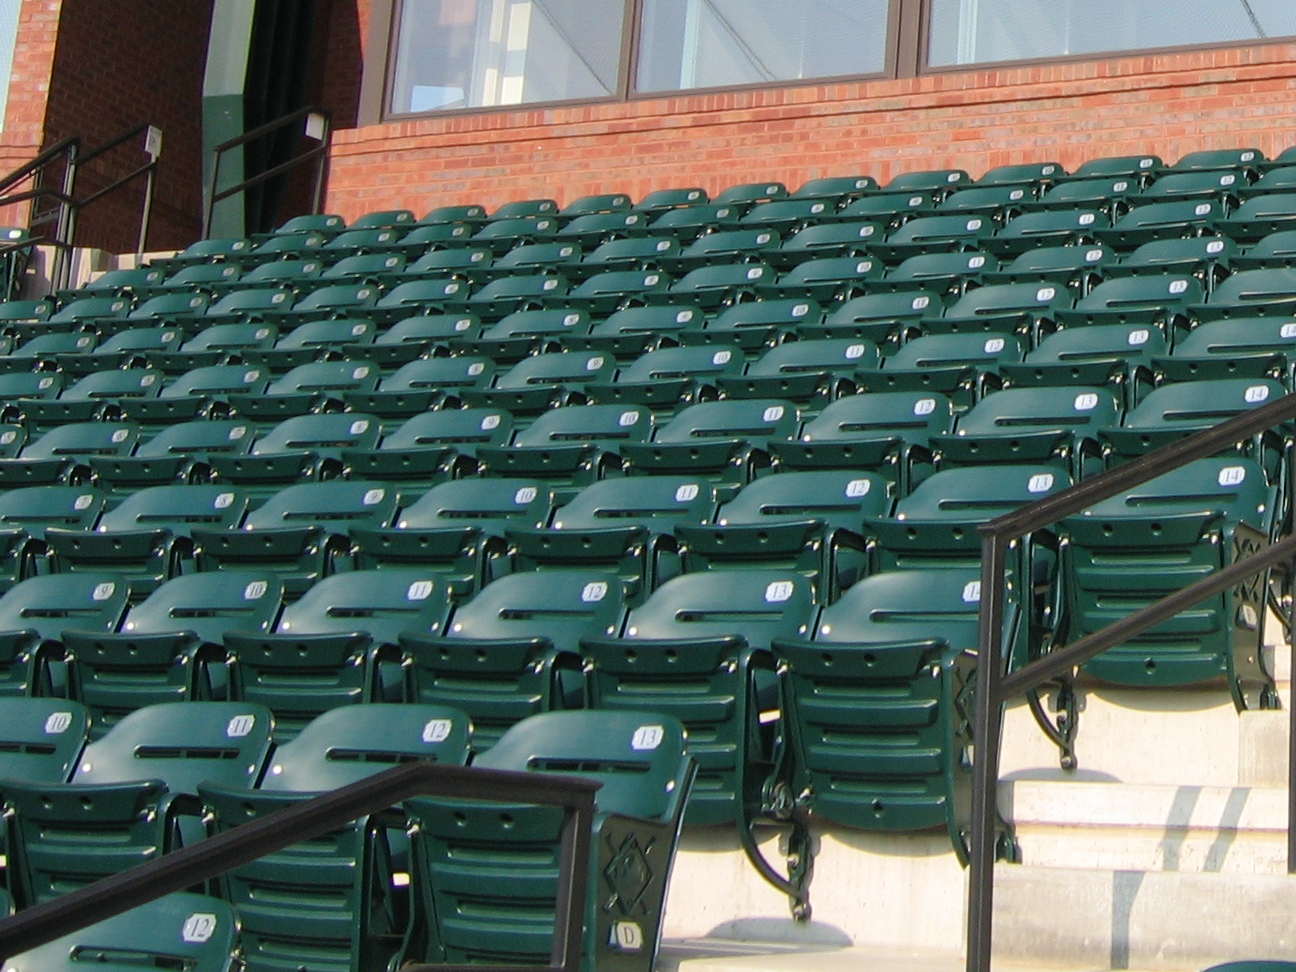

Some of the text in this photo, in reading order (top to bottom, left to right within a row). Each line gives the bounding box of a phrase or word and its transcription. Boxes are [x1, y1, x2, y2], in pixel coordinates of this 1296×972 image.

[1251, 388, 1264, 400] 14
[919, 401, 932, 413] 12
[1080, 394, 1094, 409] 13
[624, 413, 637, 424] 10
[768, 409, 779, 420] 11
[1034, 476, 1048, 490] 13
[1225, 469, 1239, 483] 14
[681, 487, 693, 499] 11
[852, 482, 865, 495] 12
[520, 490, 534, 502] 10
[100, 585, 109, 597] 9
[249, 583, 264, 597] 10
[412, 584, 427, 598] 11
[588, 585, 602, 599] 12
[772, 584, 788, 599] 13
[51, 715, 67, 731] 10
[233, 718, 248, 734] 11
[430, 722, 447, 739] 12
[640, 729, 657, 746] 13
[191, 918, 210, 938] 12
[623, 926, 635, 944] D
